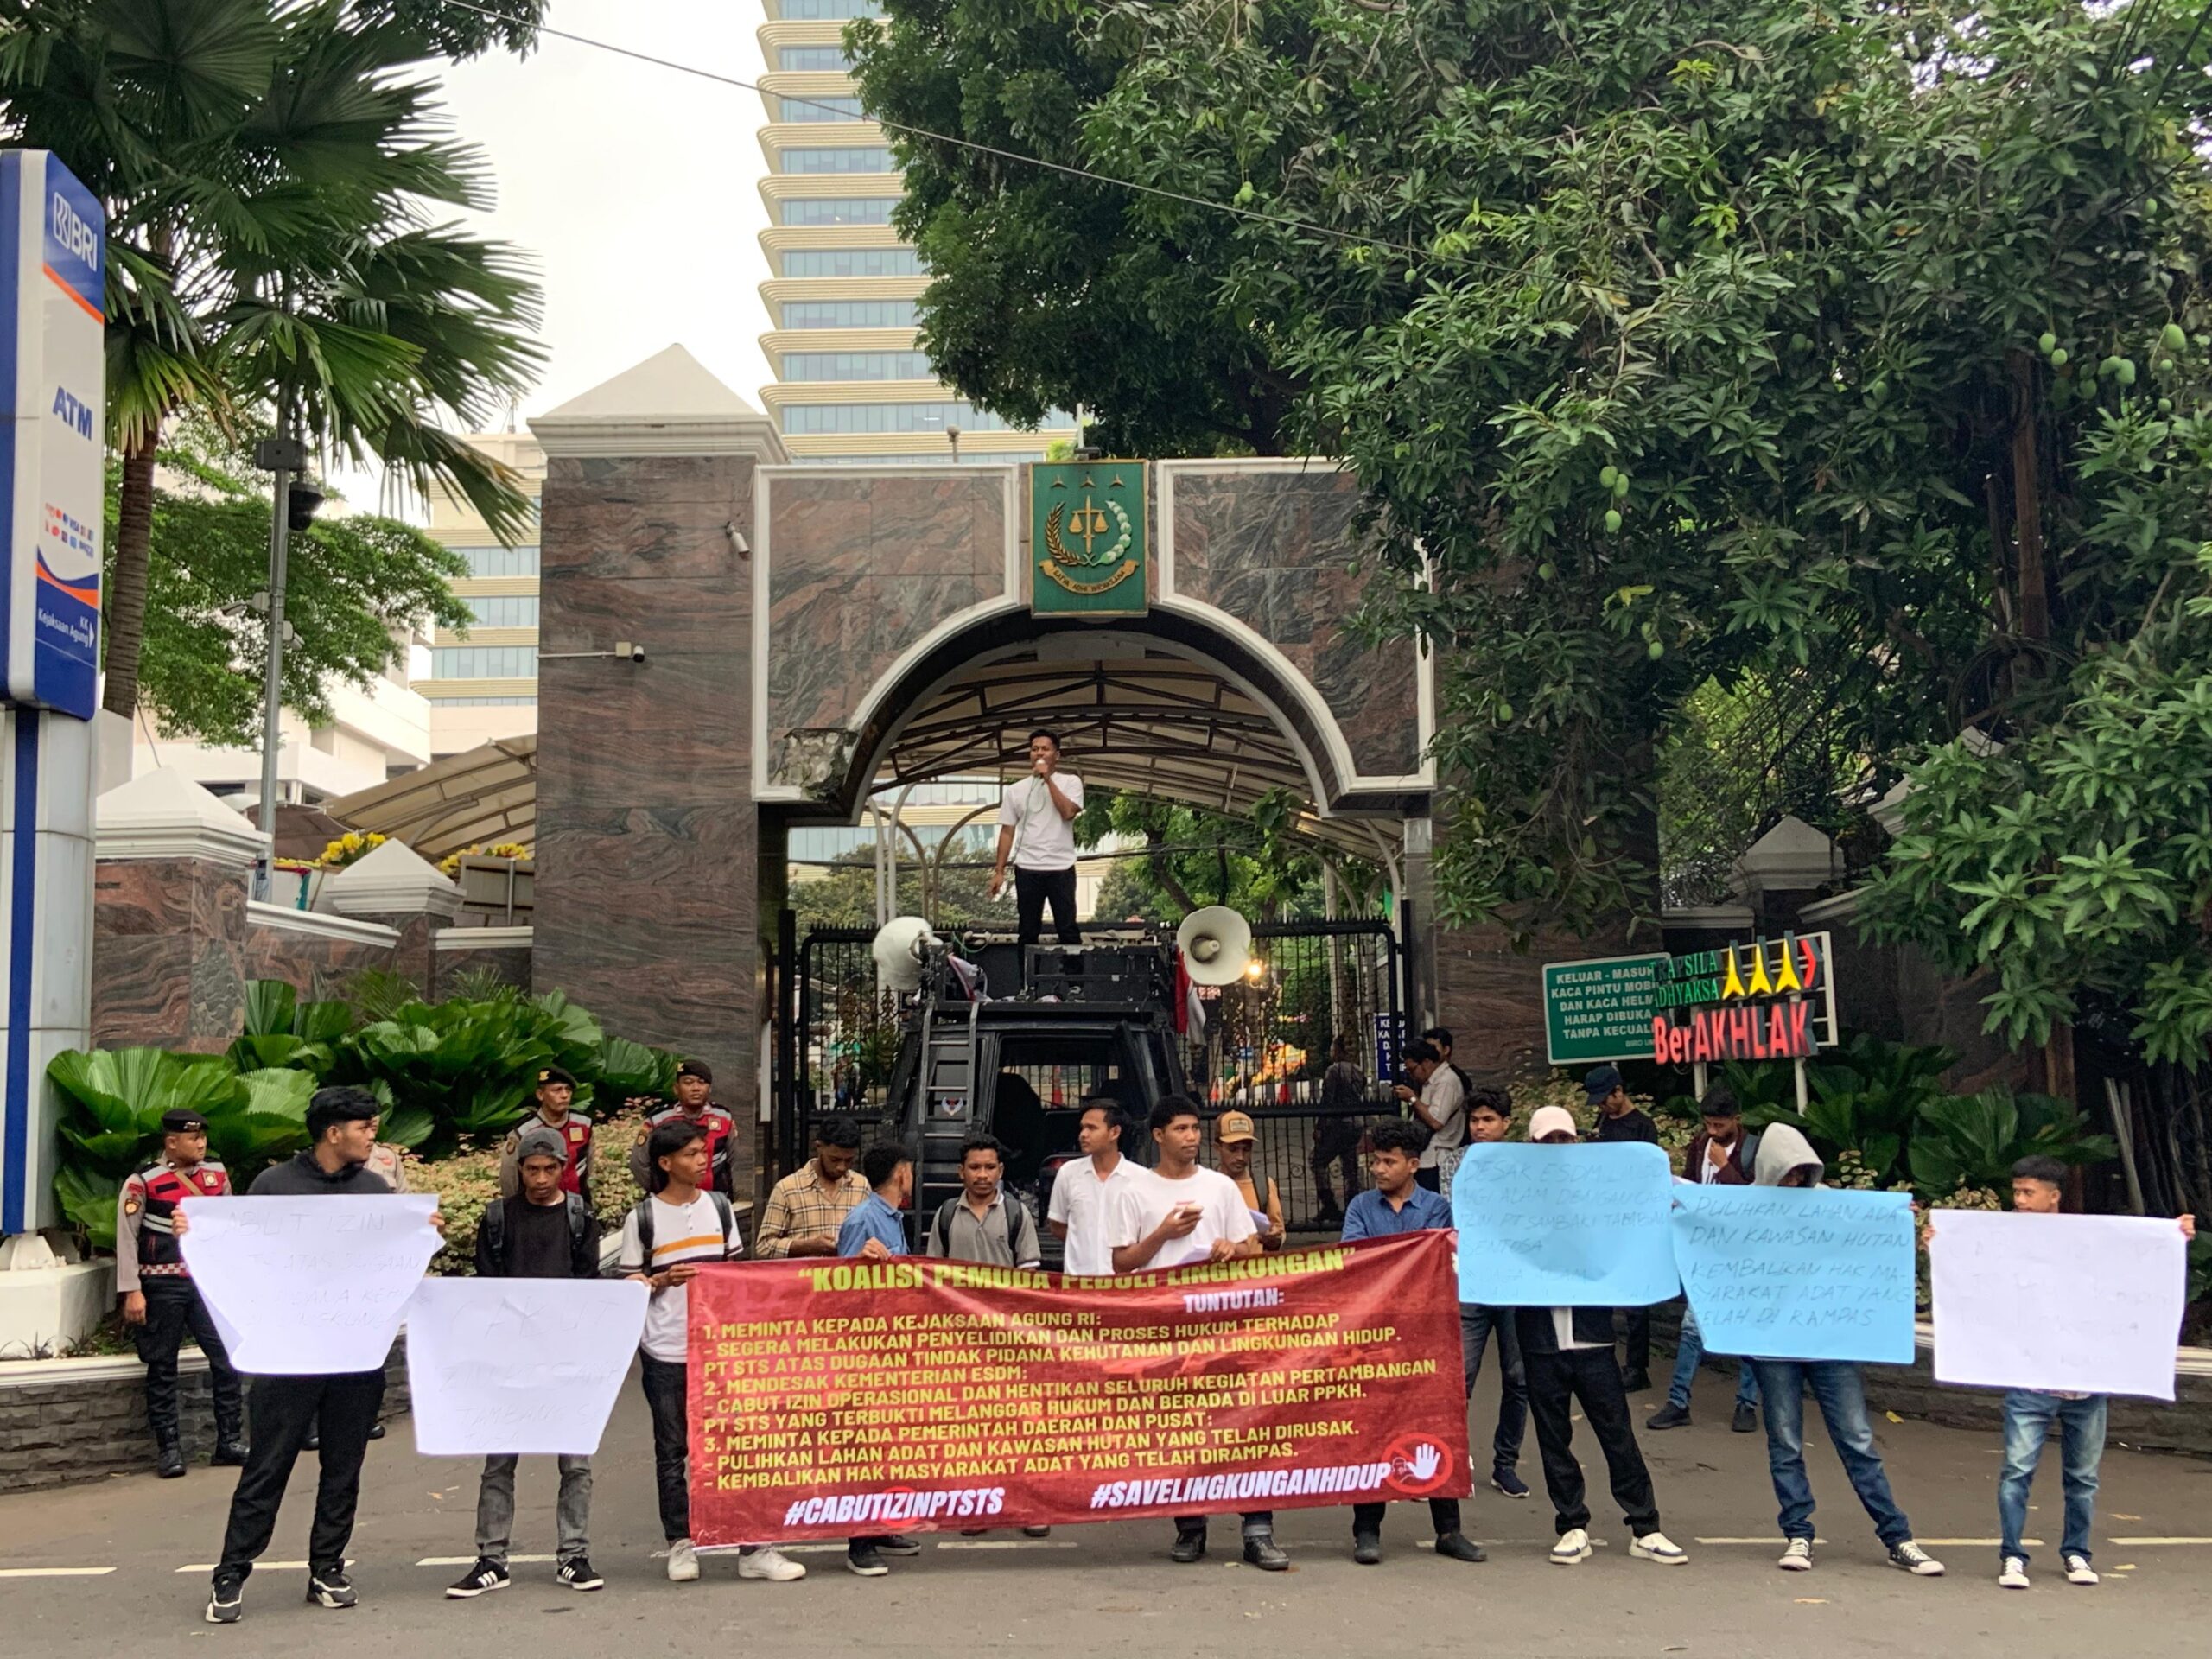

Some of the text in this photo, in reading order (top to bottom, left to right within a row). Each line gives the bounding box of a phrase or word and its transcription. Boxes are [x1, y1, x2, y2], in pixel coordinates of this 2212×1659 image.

[71, 212, 98, 272] BRI
[52, 385, 92, 442] ATM
[38, 607, 89, 648] Kejaksaan Agung
[79, 615, 89, 631] KK
[1551, 984, 1583, 998] KACA
[1586, 982, 1621, 996] PINTU
[1556, 970, 1603, 984] KELUAR
[1560, 999, 1585, 1012] DAN
[1586, 997, 1618, 1010] KACA
[1654, 977, 1719, 1008] ADHYAKSA
[1564, 1009, 1652, 1026] HARAP DIBUKA
[1562, 1027, 1600, 1039] TANPA
[1652, 1001, 1812, 1065] BerAKHLAK
[1539, 1163, 1603, 1183] ESDM
[1694, 1196, 1793, 1218] PULIHKAN
[1798, 1202, 1859, 1222] LAHAN
[1689, 1225, 1910, 1248] DAN KAWASAN HUTAN
[933, 1265, 1051, 1290] PEMUDA
[1691, 1258, 1822, 1279] KEMBALIKAN
[1828, 1262, 1866, 1277] HAK
[1184, 1287, 1285, 1313] TUNTUTAN:
[1796, 1285, 1852, 1301] ADAT
[1855, 1286, 1911, 1303] YANG
[703, 1312, 1102, 1340] 1. MEMINTA KEPADA KEJAKSAAN AGUNG RI:
[1789, 1307, 1877, 1327] RAMPAS
[717, 1339, 791, 1358] SEGERA
[796, 1334, 912, 1354] MELAKUKAN
[917, 1329, 1052, 1348] PENYELIDIKAN
[1055, 1329, 1094, 1344] DAN
[1099, 1326, 1170, 1342] PROSES
[1174, 1320, 1237, 1338] HUKUM
[1243, 1313, 1340, 1333] TERHADAP
[704, 1326, 1402, 1377] PT STS ATAS DUGAAN TINDAK PIDANA KEHUTANAN DAN LINGKUNGAN HIDUP.
[704, 1365, 1028, 1396] 2. MENDESAK KEMENTERIAN ESDM:
[717, 1395, 781, 1414] CABUT
[785, 1393, 822, 1410] IZIN
[826, 1388, 957, 1408] OPERASIONAL
[962, 1384, 1001, 1401] DAN
[1005, 1381, 1099, 1400] HENTIKAN
[1104, 1376, 1188, 1395] SELURUH
[1192, 1370, 1285, 1390] KEGIATAN
[1290, 1358, 1437, 1384] PERTAMBANGAN
[704, 1383, 1368, 1433] PT STS YANG TERBUKTI MELANGGAR HUKUM DAN BERADA DI LUAR PPKH.
[704, 1411, 1213, 1453] 3. MEMINTA KEPADA PEMERINTAH DAERAH DAN PUSAT:
[717, 1450, 814, 1471] PULIHKAN
[818, 1446, 883, 1465] LAHAN
[887, 1444, 939, 1461] ADAT
[944, 1441, 982, 1459] DAN
[988, 1436, 1083, 1456] KAWASAN
[1087, 1432, 1150, 1452] HUTAN
[1155, 1430, 1207, 1448] YANG
[1211, 1426, 1271, 1445] TELAH
[1275, 1420, 1360, 1440] DIRUSAK.
[717, 1467, 842, 1491] KEMBALIKAN
[846, 1465, 885, 1482] HAK
[889, 1458, 1019, 1480] MASYARAKAT
[1023, 1455, 1075, 1473] ADAT
[1078, 1452, 1130, 1471] YANG
[1135, 1448, 1196, 1467] TELAH
[1200, 1442, 1299, 1465] DIRAMPAS.
[1090, 1462, 1392, 1509] #SAVELINGKUNGANHIDUP
[783, 1487, 1006, 1526] #CABUTIZINPTSTS
